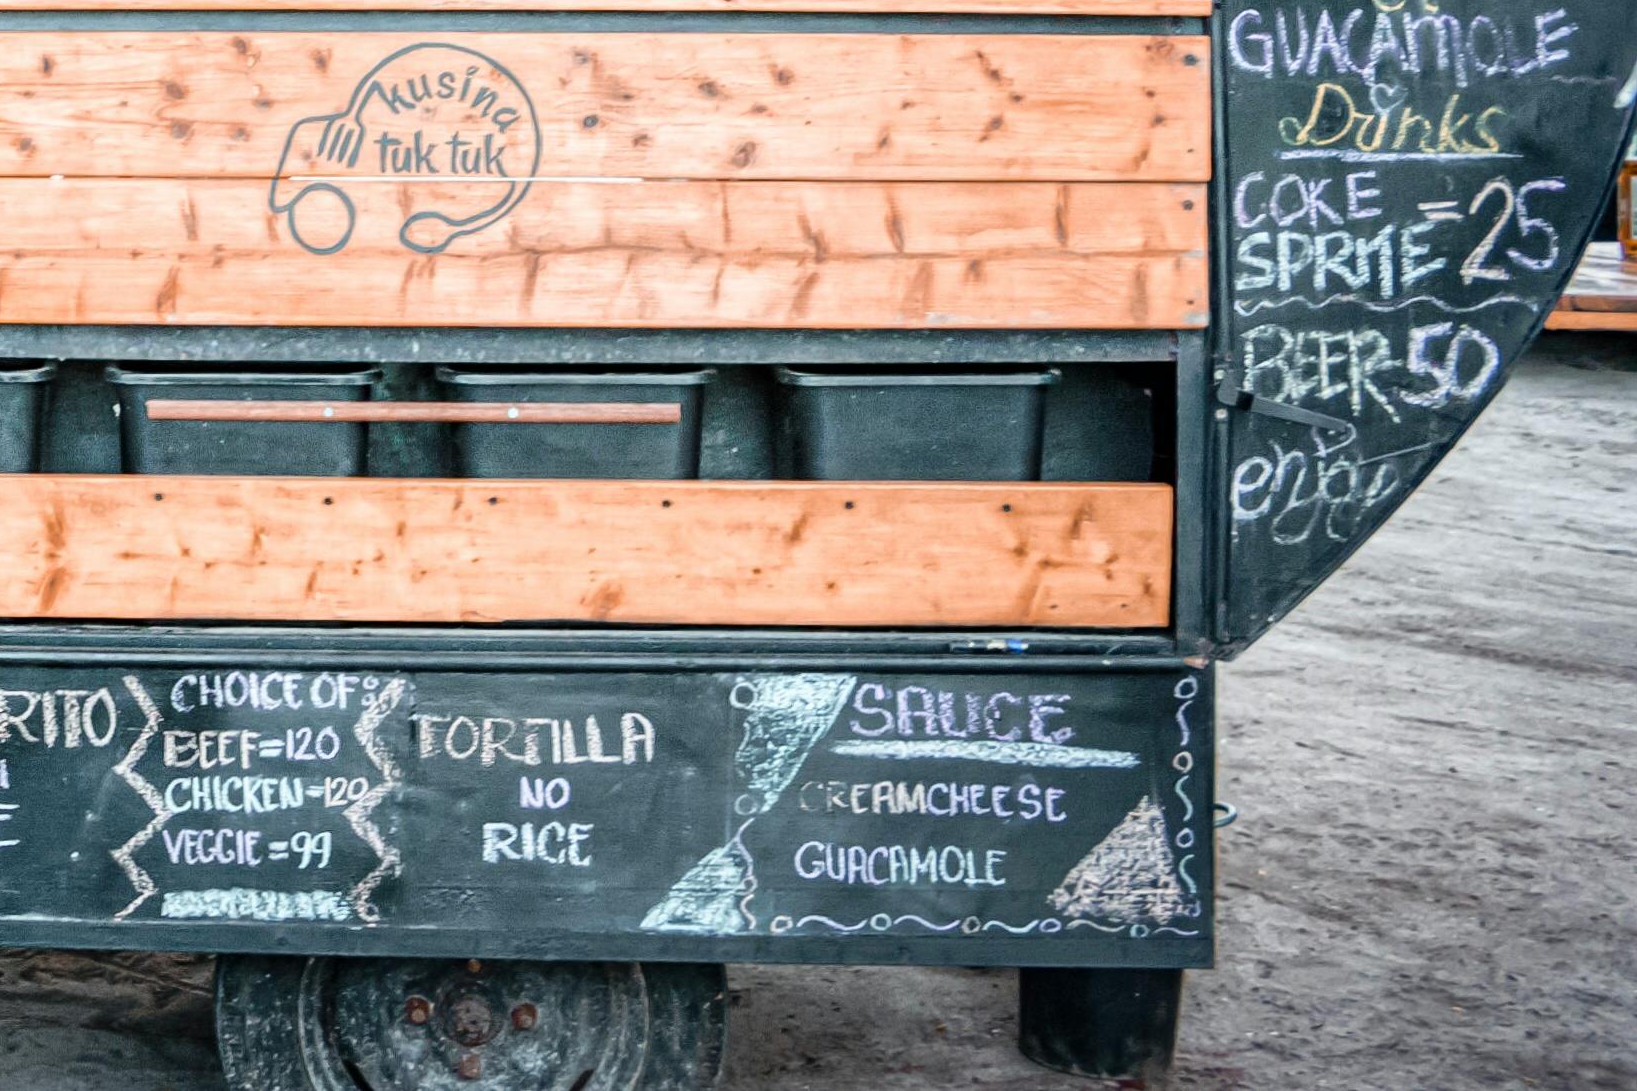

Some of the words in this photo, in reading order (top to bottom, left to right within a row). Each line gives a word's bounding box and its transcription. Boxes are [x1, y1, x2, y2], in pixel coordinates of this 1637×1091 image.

[374, 131, 439, 174] tuk
[445, 131, 507, 176] tuk
[1233, 171, 1382, 229] COKE
[170, 671, 304, 713] CHOICE
[850, 681, 1076, 743] SAUCE
[409, 712, 656, 767] TORTILLA
[520, 776, 570, 809] NO
[482, 821, 594, 866] RICE
[794, 840, 1007, 887] GUACAMOLE
